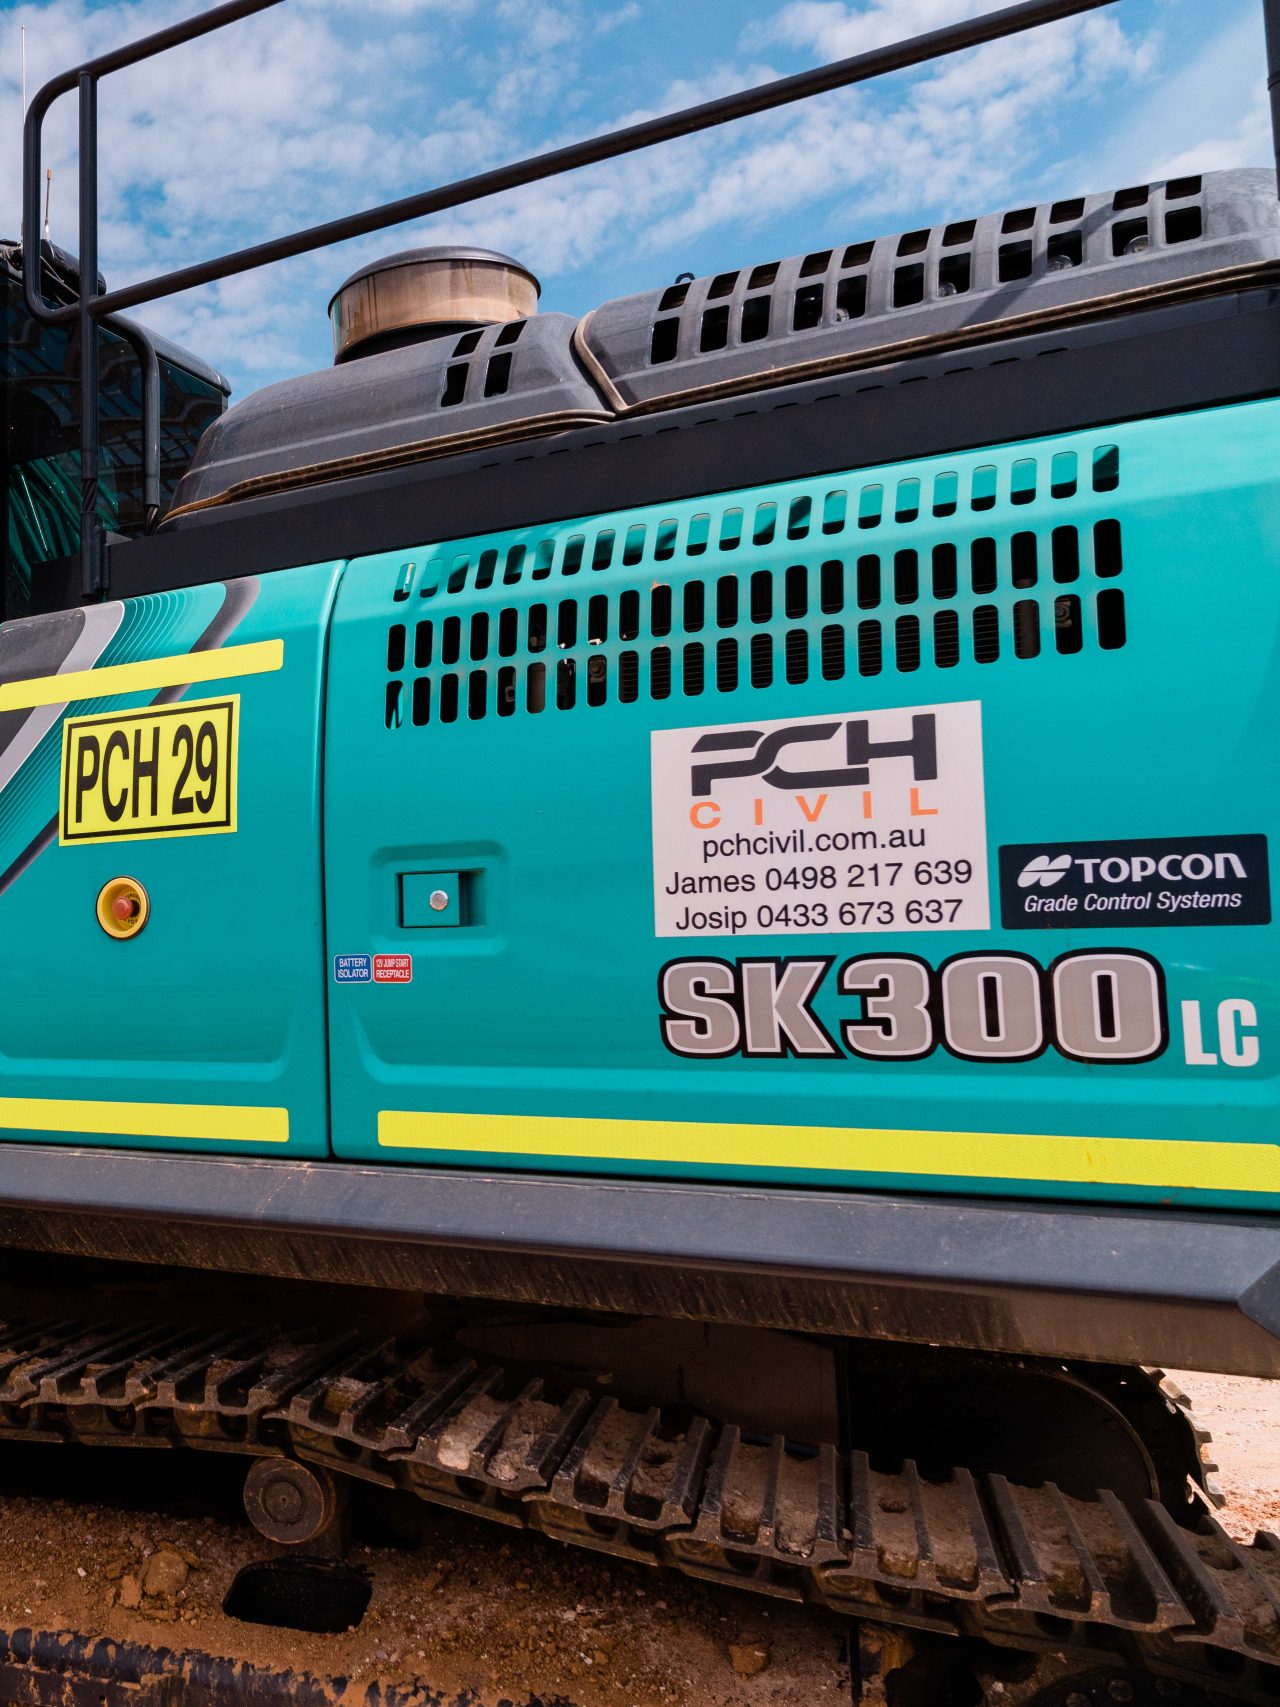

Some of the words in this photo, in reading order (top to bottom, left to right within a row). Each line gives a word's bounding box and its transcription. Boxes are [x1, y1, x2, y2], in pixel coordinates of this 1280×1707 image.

[75, 726, 160, 823] PCH
[171, 720, 218, 815] 29
[690, 713, 938, 797] PCH
[689, 787, 939, 830] CIVIL
[702, 828, 926, 863] pchcivil.com.au
[665, 871, 756, 895] James
[765, 865, 837, 891] 0498
[847, 862, 904, 888] 217
[914, 859, 973, 886] 639
[1074, 852, 1248, 884] TOPCON
[676, 906, 747, 934] Josip
[756, 904, 828, 928] 0433
[838, 901, 895, 926] 673
[904, 899, 963, 924] 637
[1024, 894, 1078, 912] Grade
[1083, 892, 1152, 911] Control
[1156, 890, 1243, 912] Systems
[338, 968, 369, 978] ISOLATOR
[339, 958, 367, 967] BATTERY
[376, 969, 409, 979] RECEPTACLE
[384, 959, 395, 967] JUMP
[396, 959, 409, 967] START
[659, 947, 1169, 1065] SK300
[1181, 998, 1260, 1067] LC
